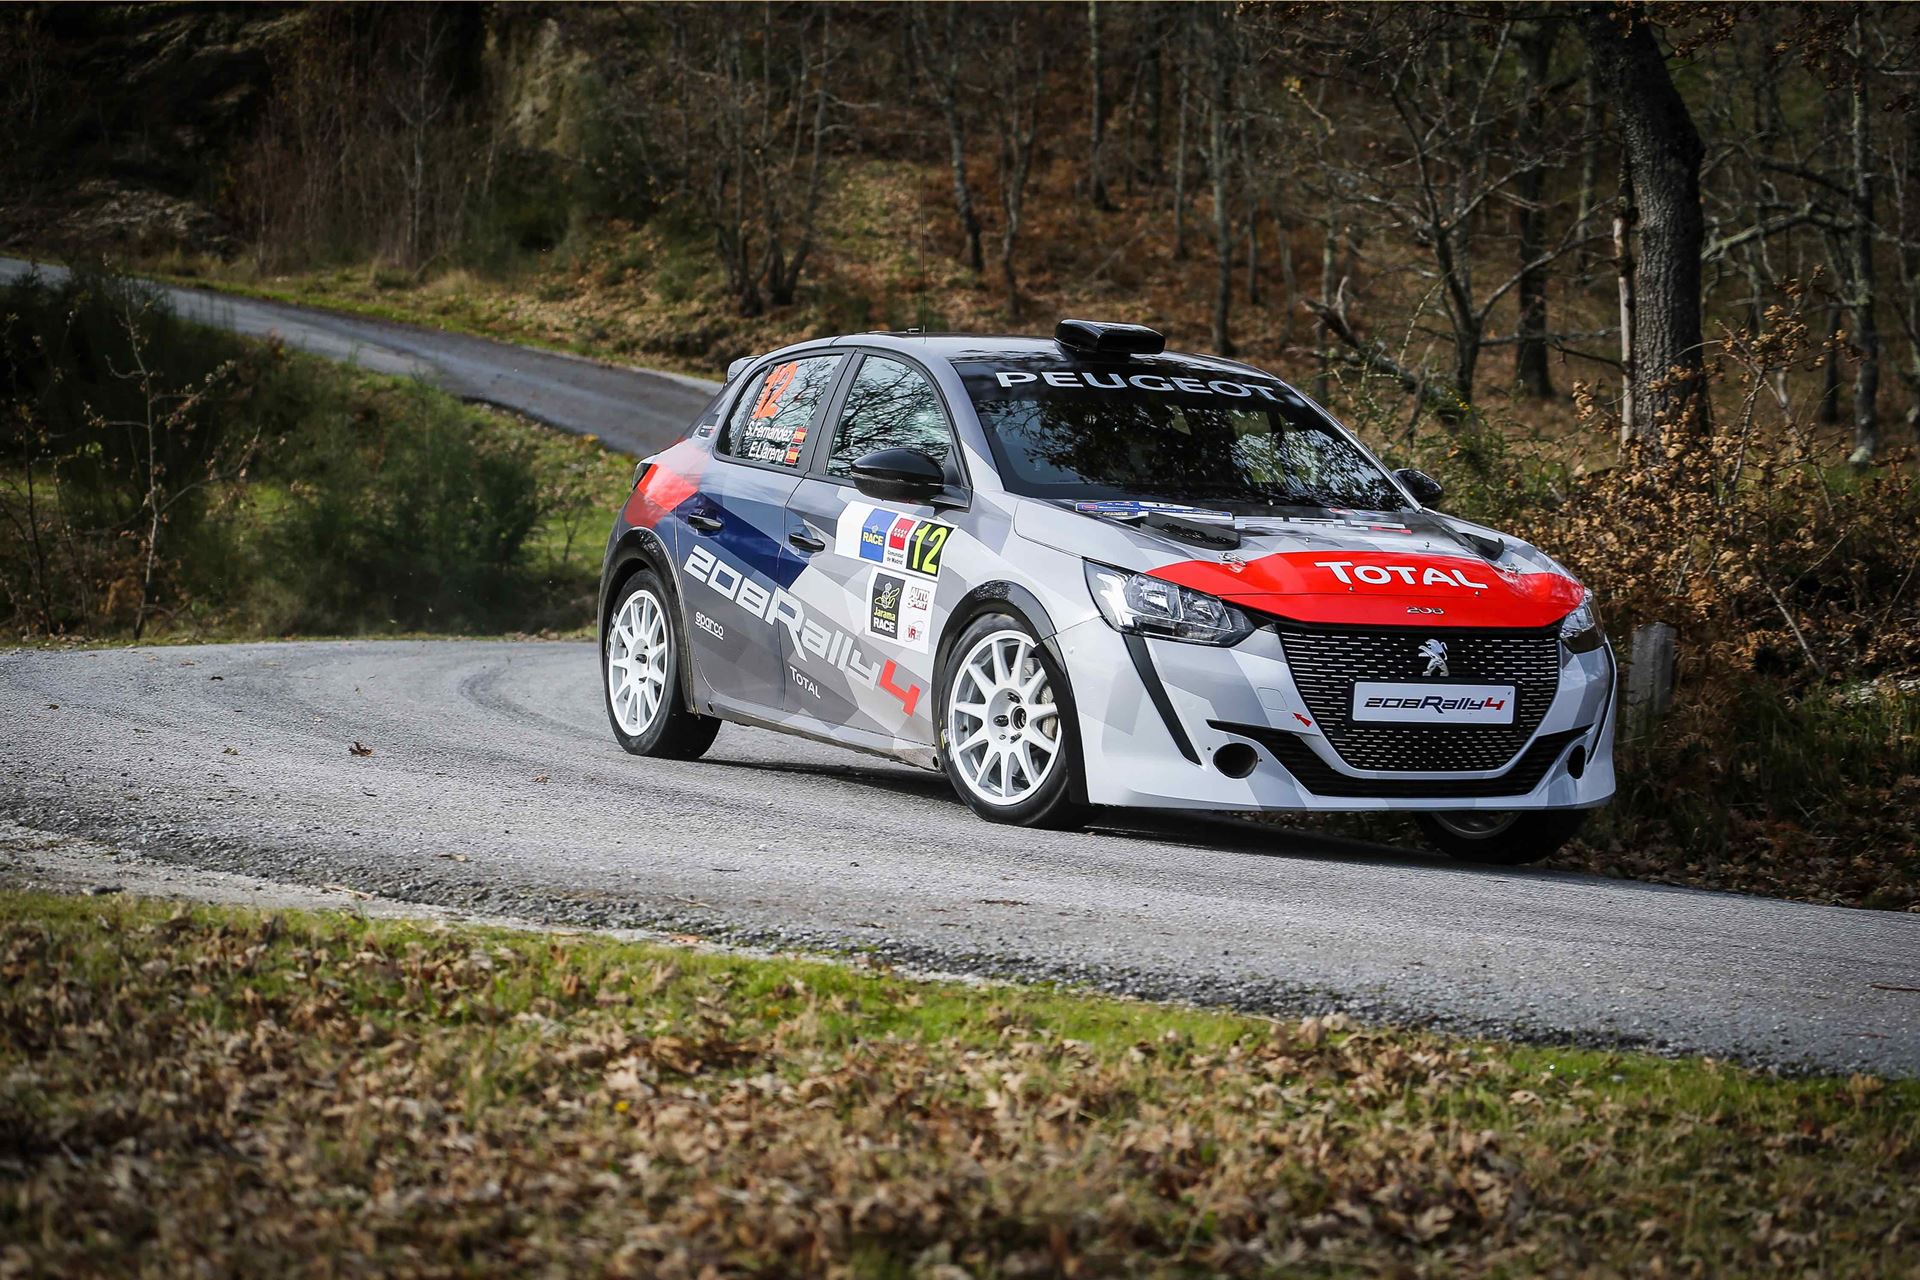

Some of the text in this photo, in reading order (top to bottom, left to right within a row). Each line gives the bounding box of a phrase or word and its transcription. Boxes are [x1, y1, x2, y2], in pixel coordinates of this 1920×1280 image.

[995, 371, 1280, 401] PEUGEOT
[862, 532, 883, 546] RACE
[913, 523, 948, 574] 12
[1314, 561, 1488, 589] TOTAL
[911, 586, 930, 602] AUTO
[695, 611, 725, 638] sparco
[873, 606, 896, 621] Jarama
[873, 617, 896, 633] RACE
[789, 665, 822, 699] TOTAL
